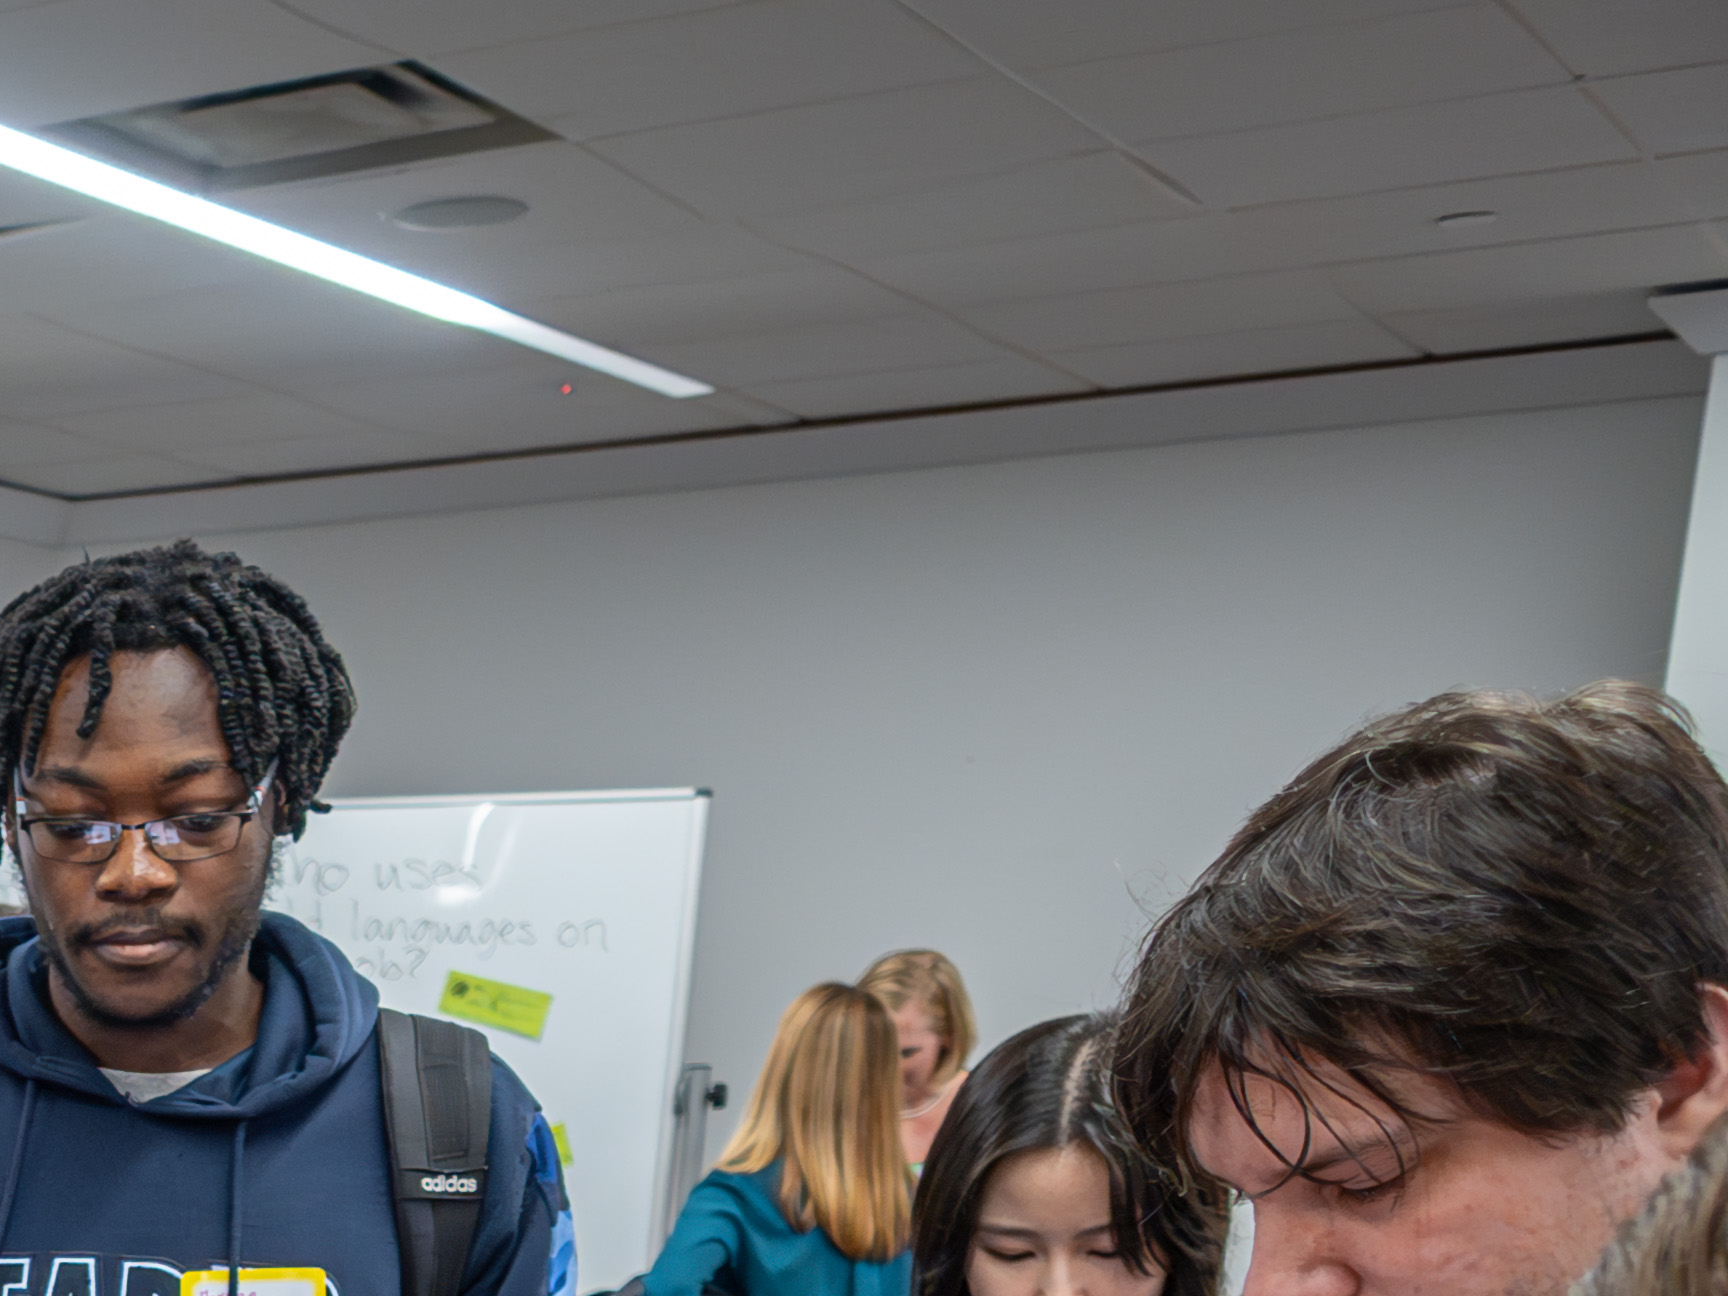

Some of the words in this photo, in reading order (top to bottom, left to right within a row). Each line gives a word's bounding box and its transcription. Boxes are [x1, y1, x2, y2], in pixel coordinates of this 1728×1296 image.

[349, 897, 539, 961] languages
[556, 917, 610, 953] on
[354, 945, 431, 982] ob?
[421, 1174, 478, 1193] adidas
